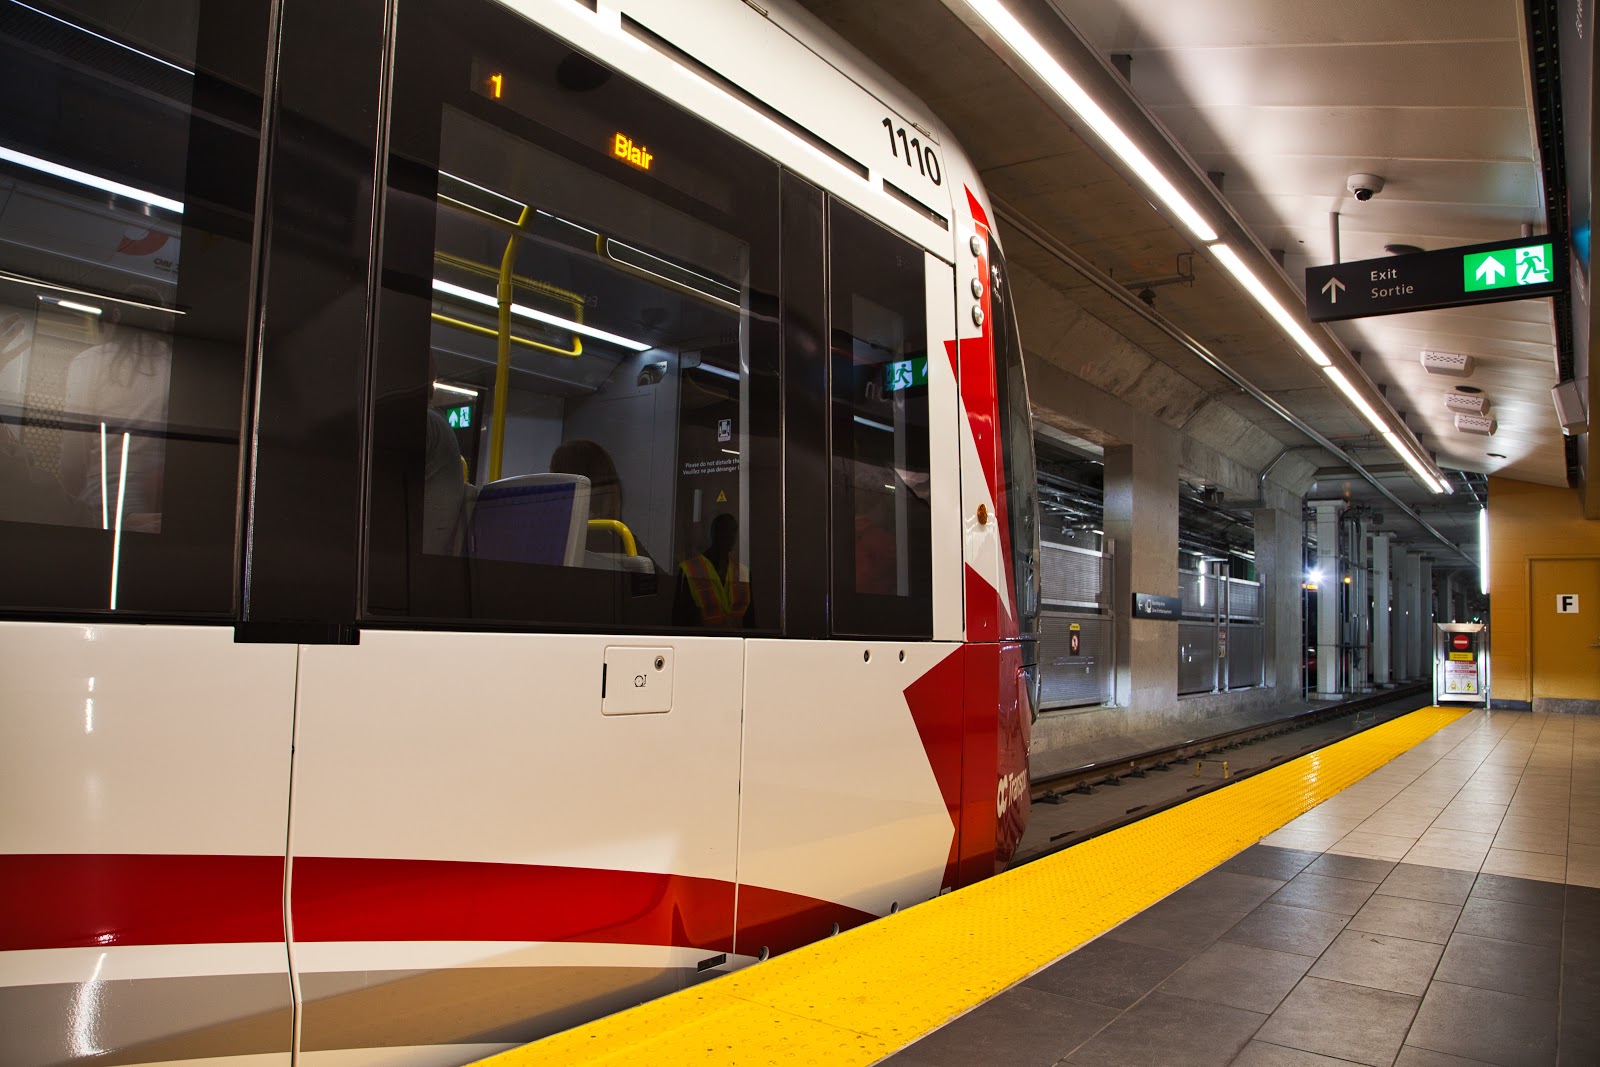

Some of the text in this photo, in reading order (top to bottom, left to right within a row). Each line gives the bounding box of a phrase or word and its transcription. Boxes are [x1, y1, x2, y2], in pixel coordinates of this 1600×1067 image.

[491, 74, 502, 98] 1
[614, 132, 653, 170] Blair
[882, 117, 941, 186] 1110
[1370, 268, 1397, 281] Exit
[1371, 283, 1414, 298] Sortie
[715, 458, 732, 466] disturb
[1562, 596, 1573, 611] F
